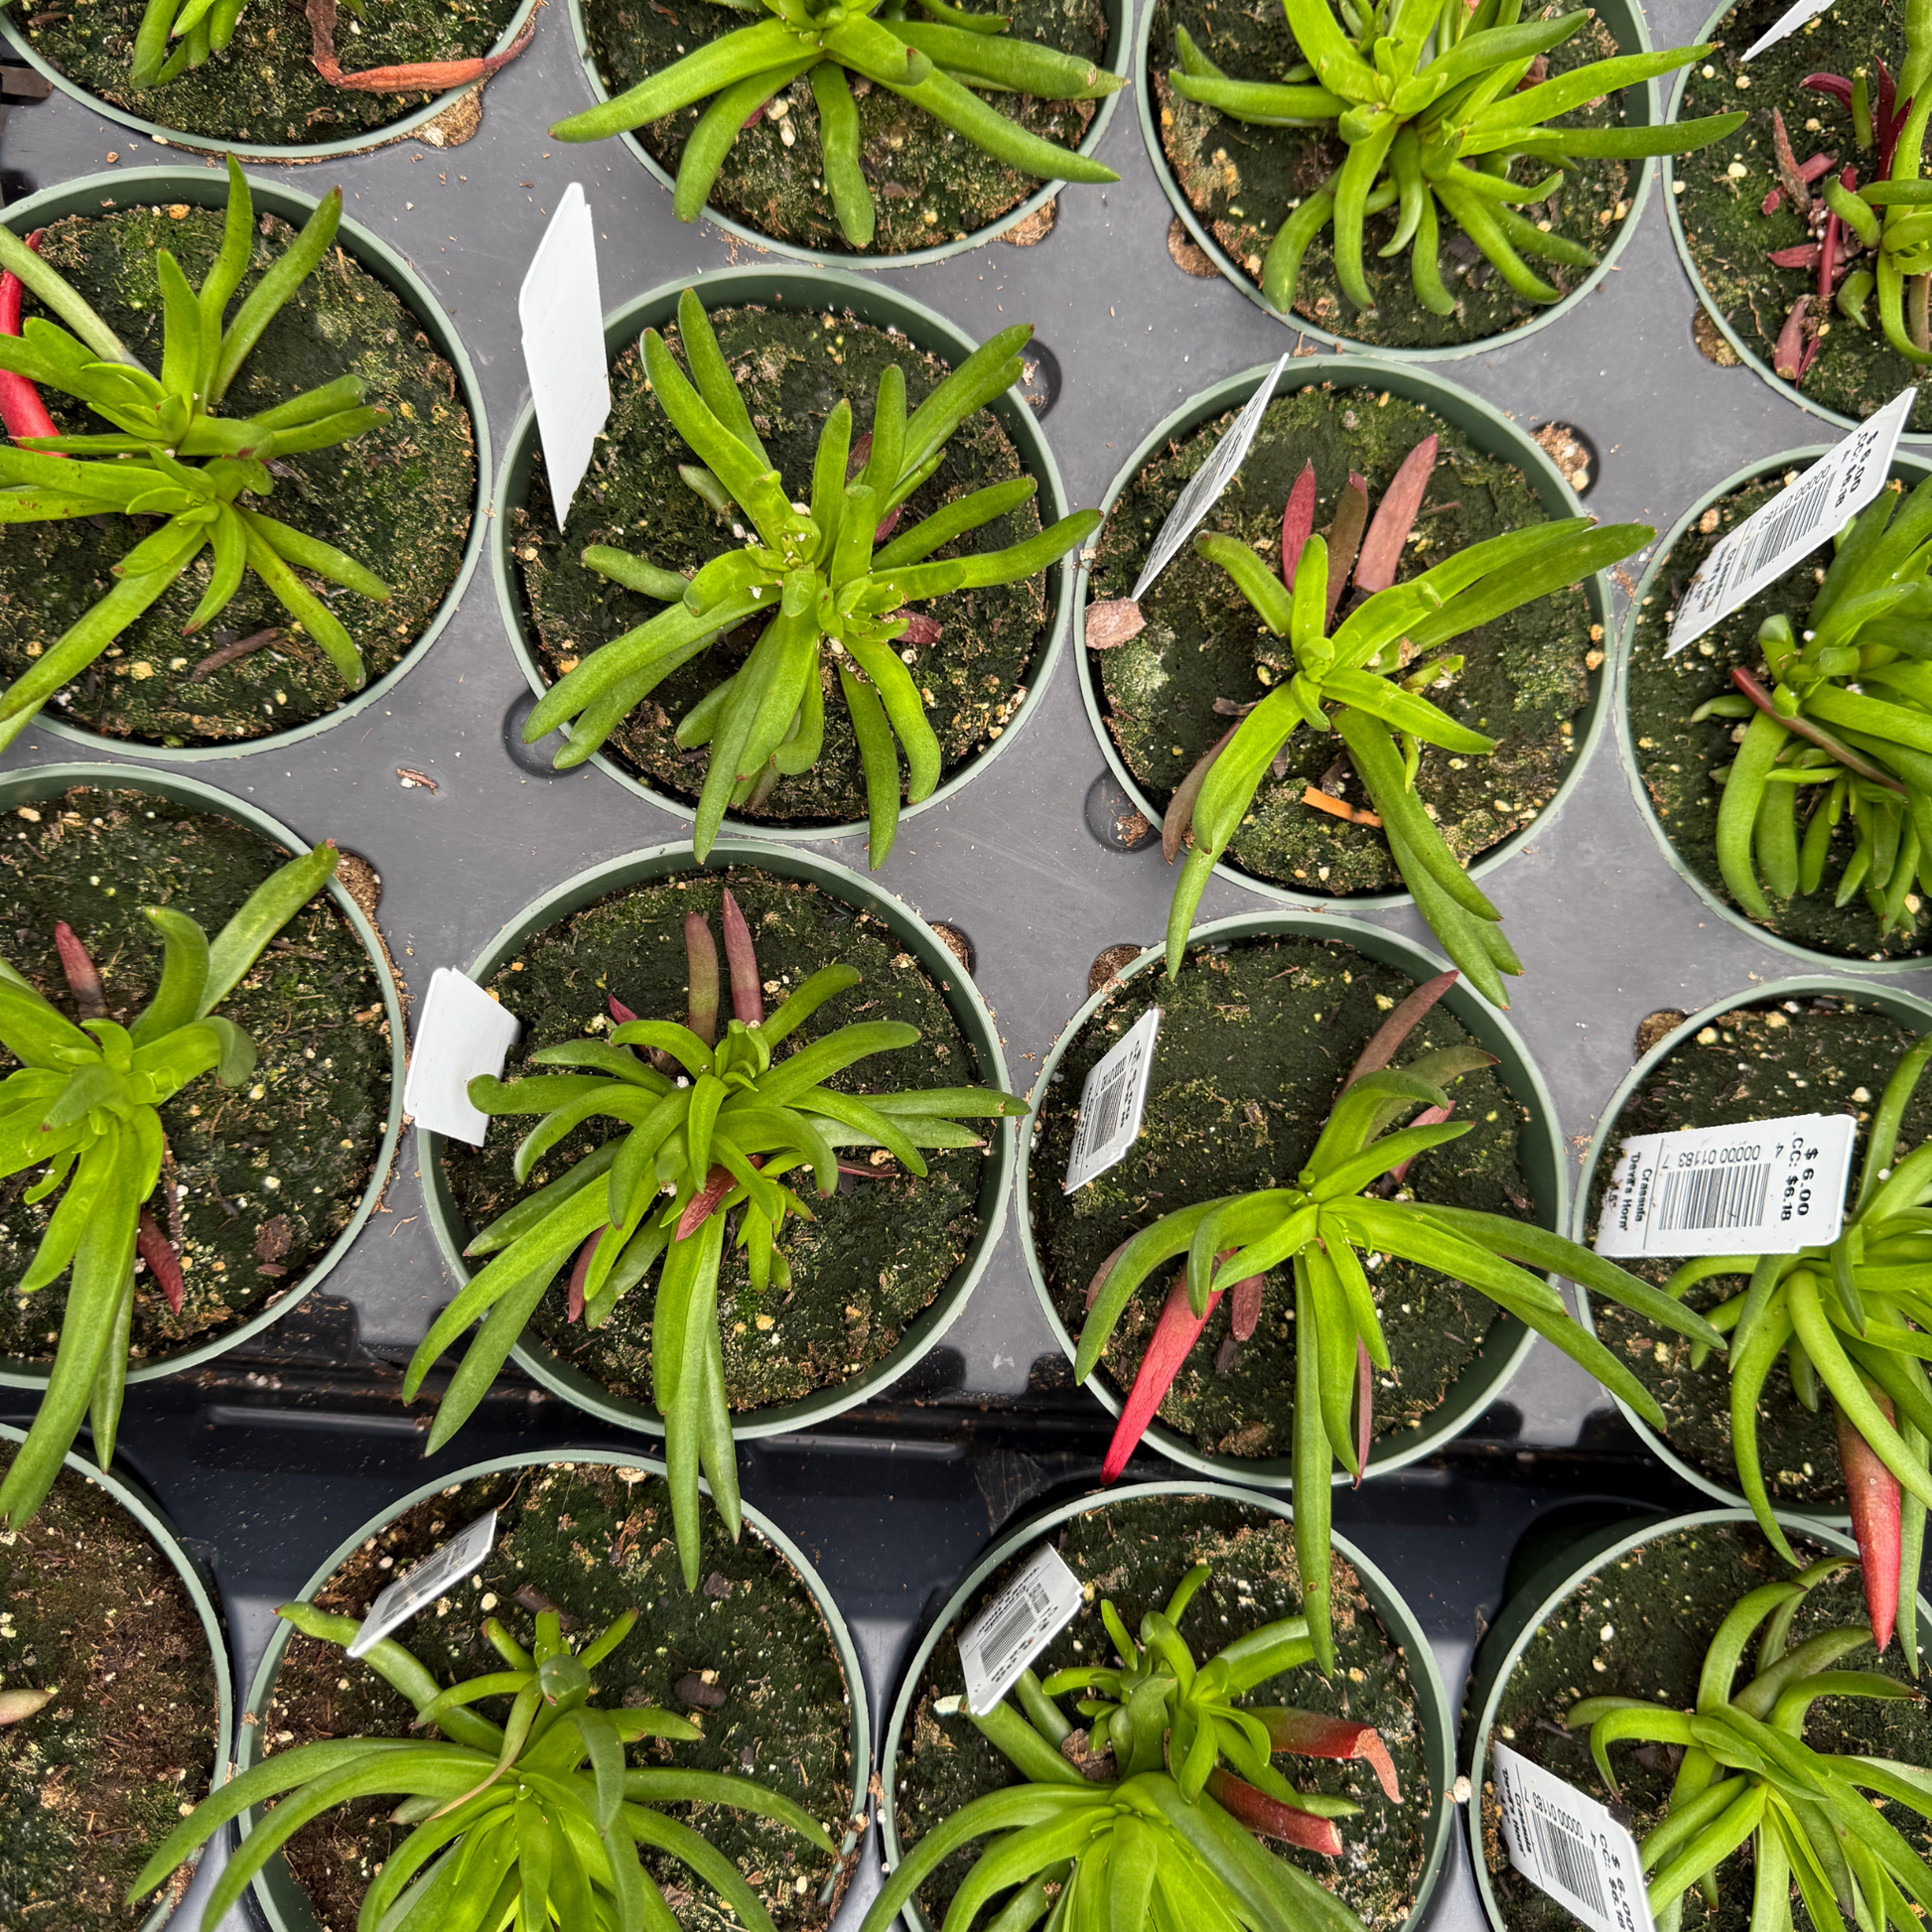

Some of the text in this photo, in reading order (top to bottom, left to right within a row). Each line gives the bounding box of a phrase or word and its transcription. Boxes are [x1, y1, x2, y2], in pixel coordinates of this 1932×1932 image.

[1851, 432, 1868, 462] CC:
[1850, 448, 1871, 493] 6.00
[1678, 1150, 1717, 1168] 01183
[1720, 1145, 1761, 1164] 00000
[1635, 1169, 1653, 1222] Crassula
[1781, 1137, 1804, 1221] CC: $6.18
[1797, 1148, 1819, 1216] $ 6.00
[1558, 1808, 1584, 1840] 00000
[1599, 1834, 1610, 1868] CC:
[1616, 1877, 1635, 1932] 6.00
